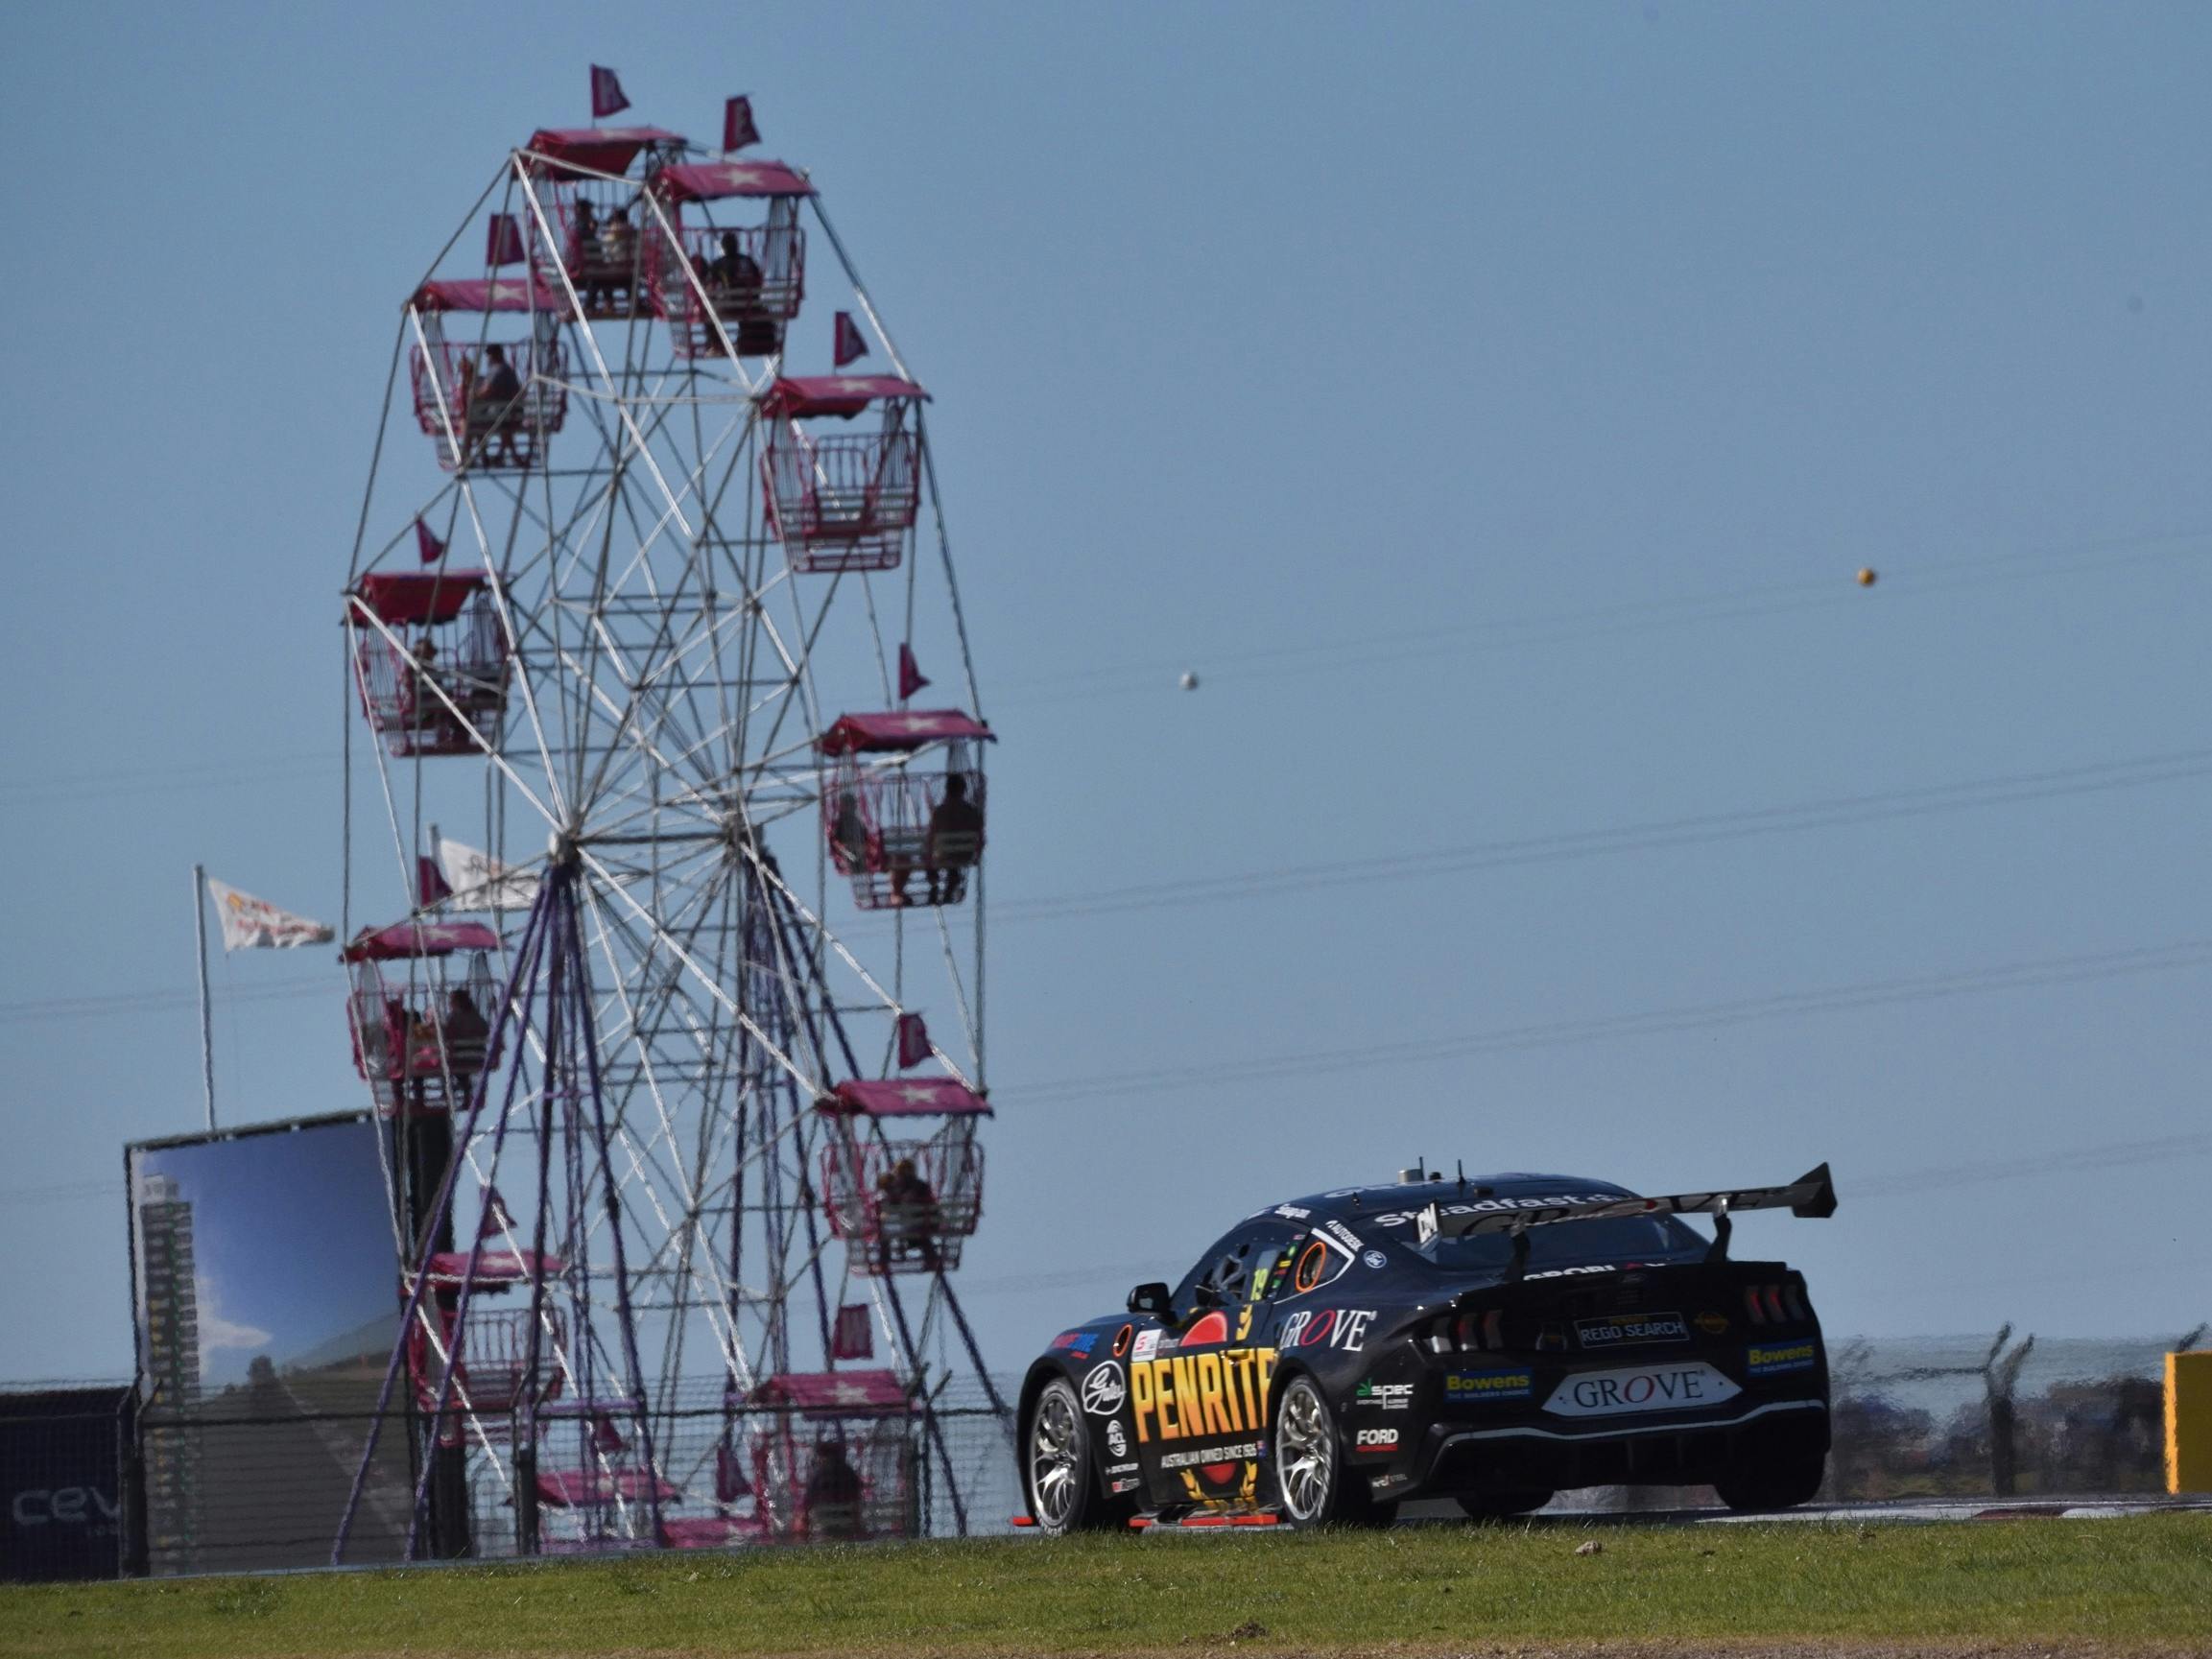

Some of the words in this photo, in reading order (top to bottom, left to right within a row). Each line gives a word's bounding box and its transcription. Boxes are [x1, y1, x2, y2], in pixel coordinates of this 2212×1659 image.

[1250, 1268, 1268, 1301] 19
[1279, 1309, 1371, 1352] GROVE
[1581, 1326, 1622, 1342] REGO
[1626, 1320, 1684, 1338] SEARCH
[1749, 1345, 1814, 1365] Bowens
[1447, 1374, 1530, 1391] Bowens
[1574, 1371, 1702, 1409] GROVE
[1356, 1429, 1399, 1445] FORD
[1161, 1451, 1201, 1469] AUSTRALIAN
[1201, 1447, 1224, 1463] OWNED
[1224, 1444, 1243, 1459] SINCE
